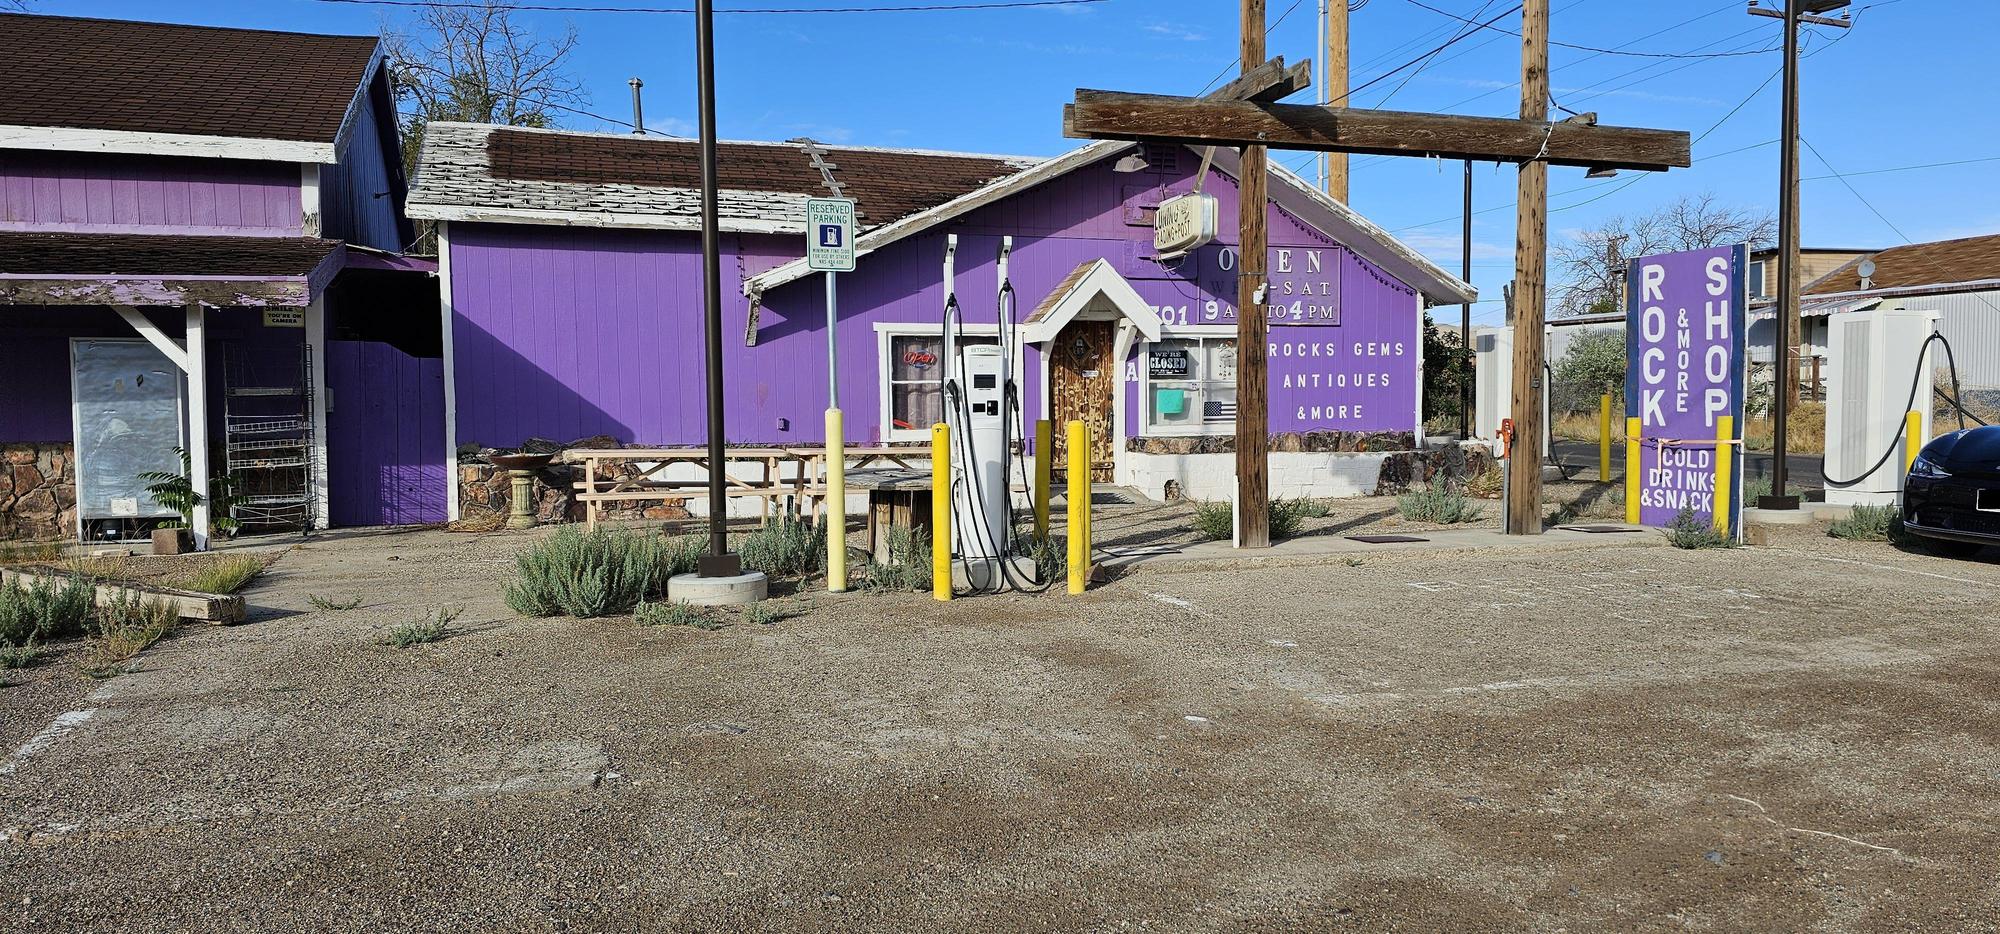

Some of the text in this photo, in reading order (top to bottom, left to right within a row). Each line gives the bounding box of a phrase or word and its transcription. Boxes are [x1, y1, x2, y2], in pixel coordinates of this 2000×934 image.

[811, 204, 849, 214] RESERVED
[814, 214, 847, 224] PARKING
[1219, 249, 1321, 272] OEN
[1269, 342, 1404, 357] ROCKS GEMS
[1641, 256, 1729, 428] ROCK SHOP
[1150, 357, 1187, 369] CLOSED
[1283, 373, 1390, 389] ANTIQUES
[1297, 404, 1363, 420] &MORE
[1662, 448, 1709, 469] COLD
